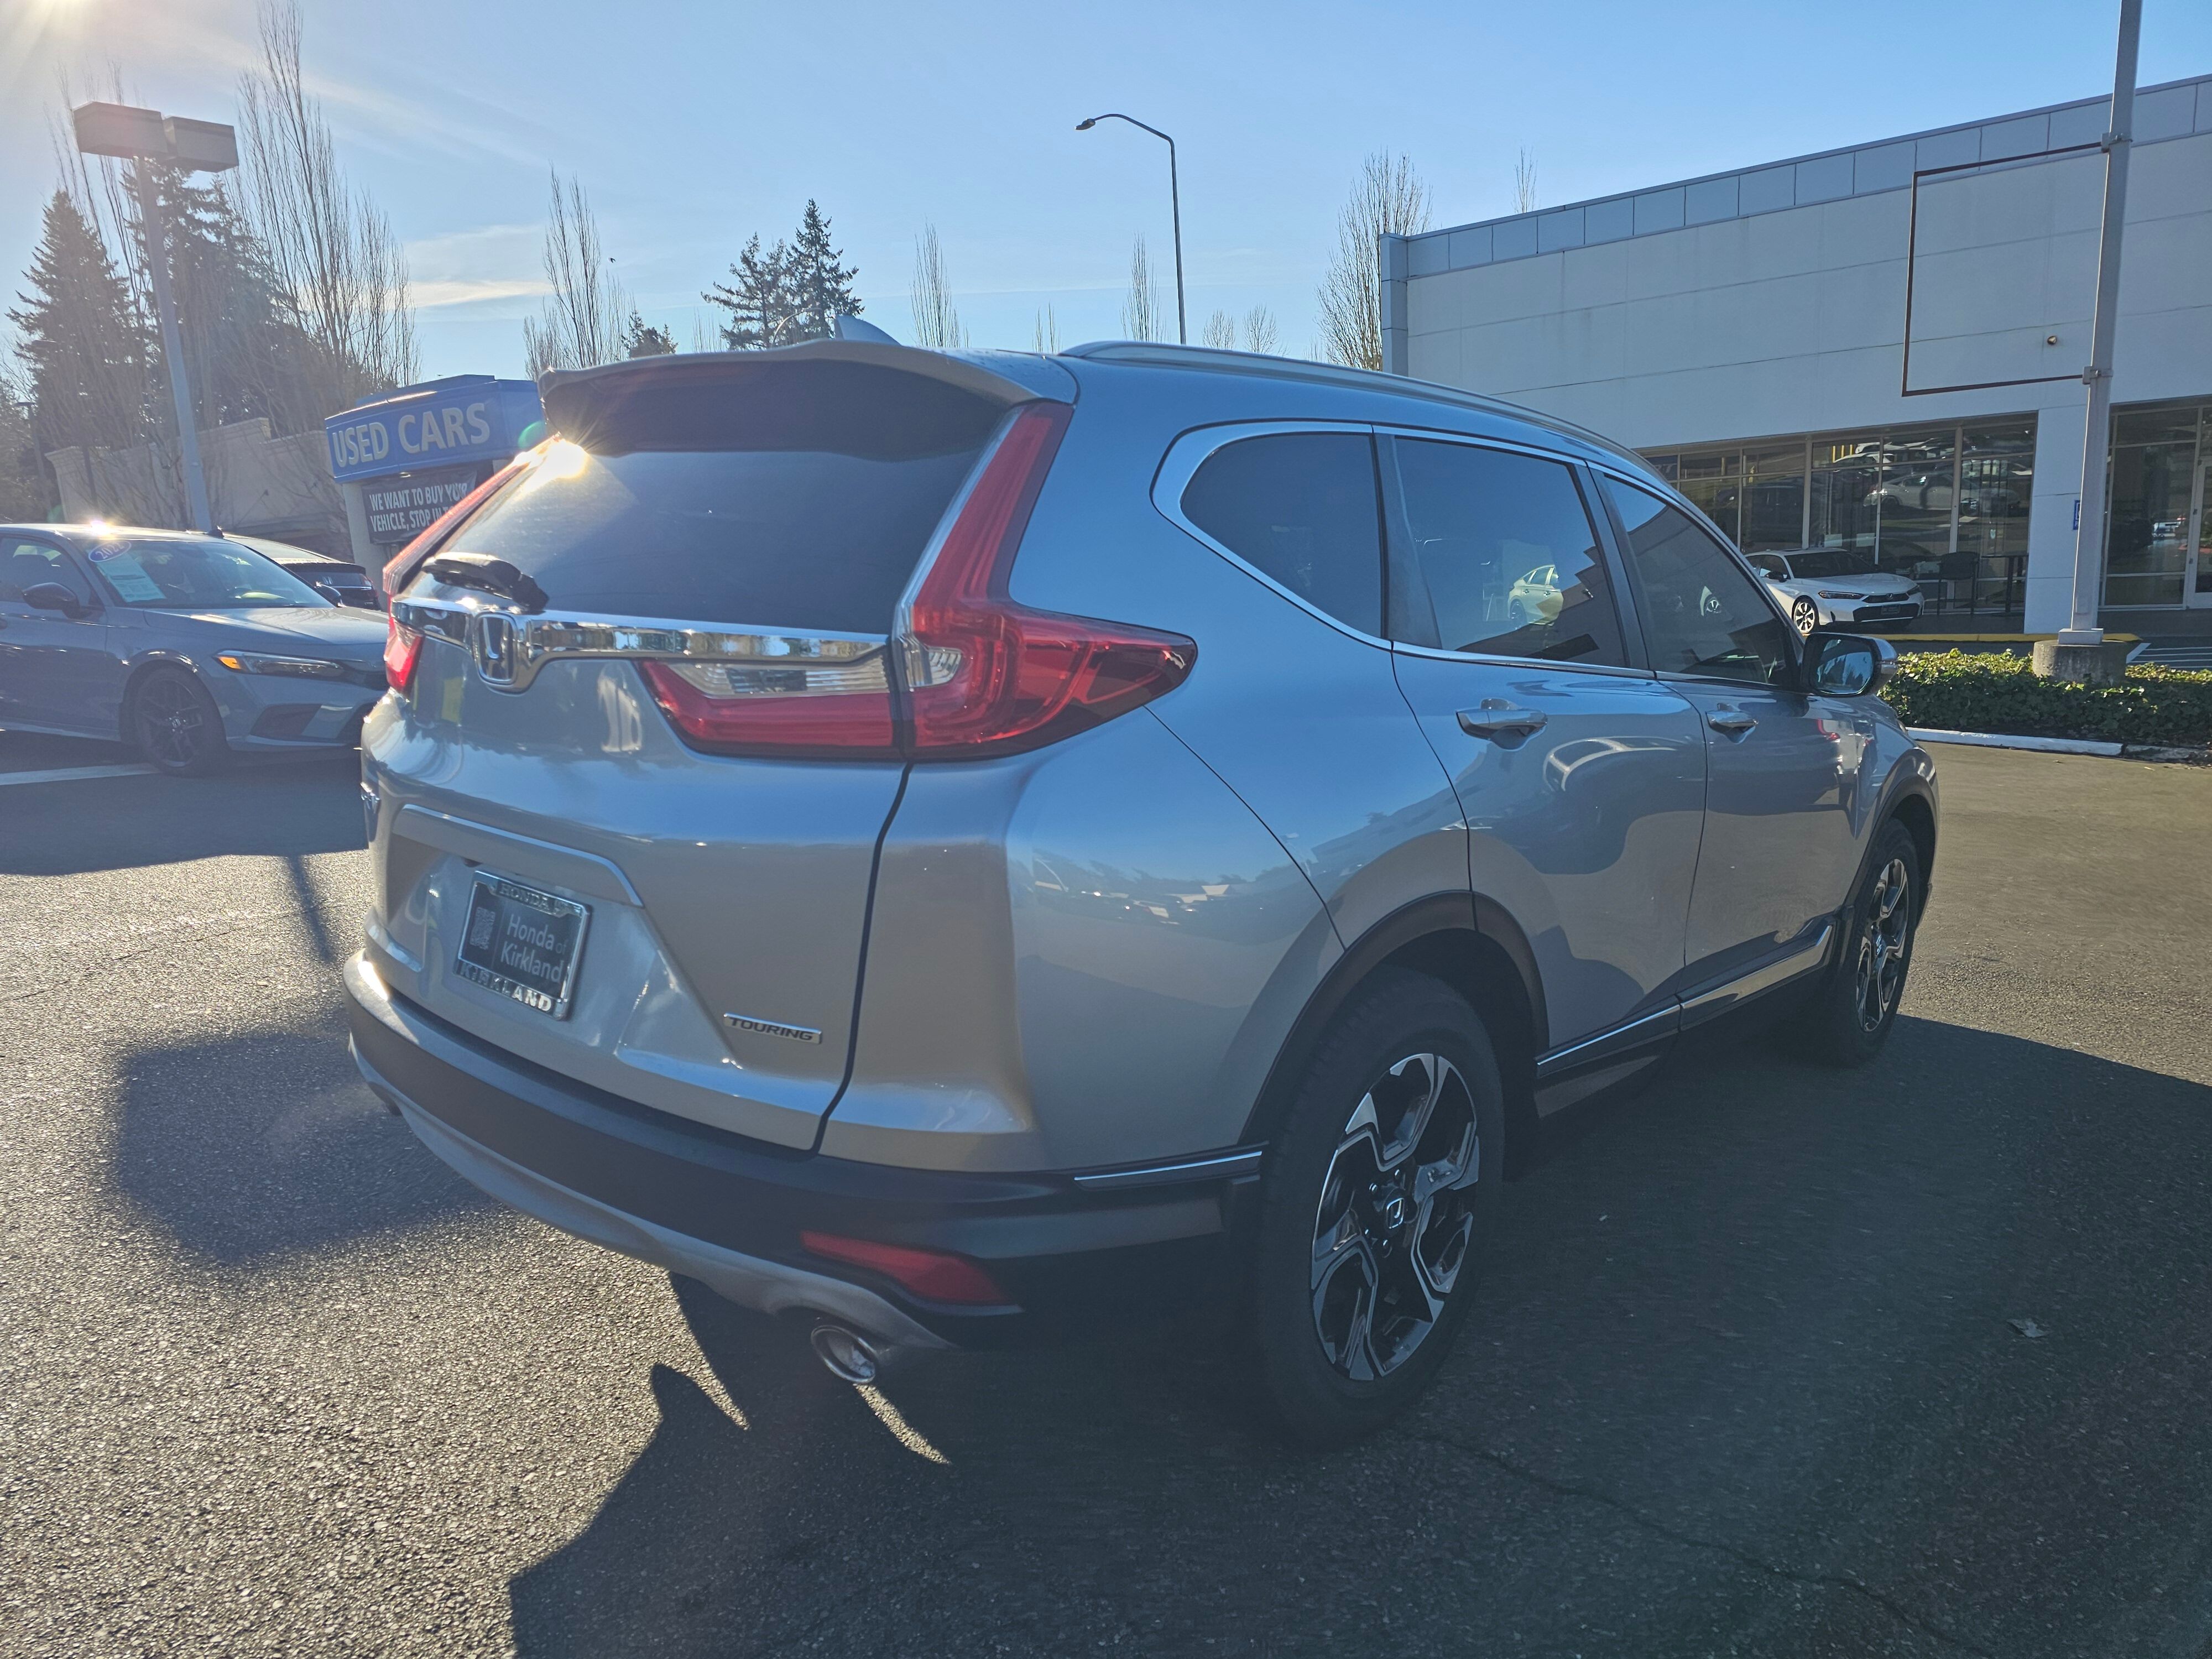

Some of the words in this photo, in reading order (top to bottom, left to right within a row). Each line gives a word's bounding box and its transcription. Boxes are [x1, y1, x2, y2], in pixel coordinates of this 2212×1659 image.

[332, 422, 389, 468] USED
[398, 403, 491, 454] CARS
[369, 493, 384, 511] WE
[384, 489, 410, 509] WANT
[411, 488, 424, 506] TO
[425, 484, 443, 505] BUY
[445, 483, 467, 501] YOUR
[370, 512, 410, 532] VEHICLE,
[409, 509, 431, 528] STOP
[432, 507, 442, 522] IN
[95, 542, 125, 559] 2022
[499, 883, 550, 911] HONDA
[507, 914, 555, 951] Honda
[555, 939, 569, 954] of
[501, 941, 564, 983] Kirkland
[460, 962, 552, 1011] KIRKLAND
[728, 1016, 815, 1041] TOURING
